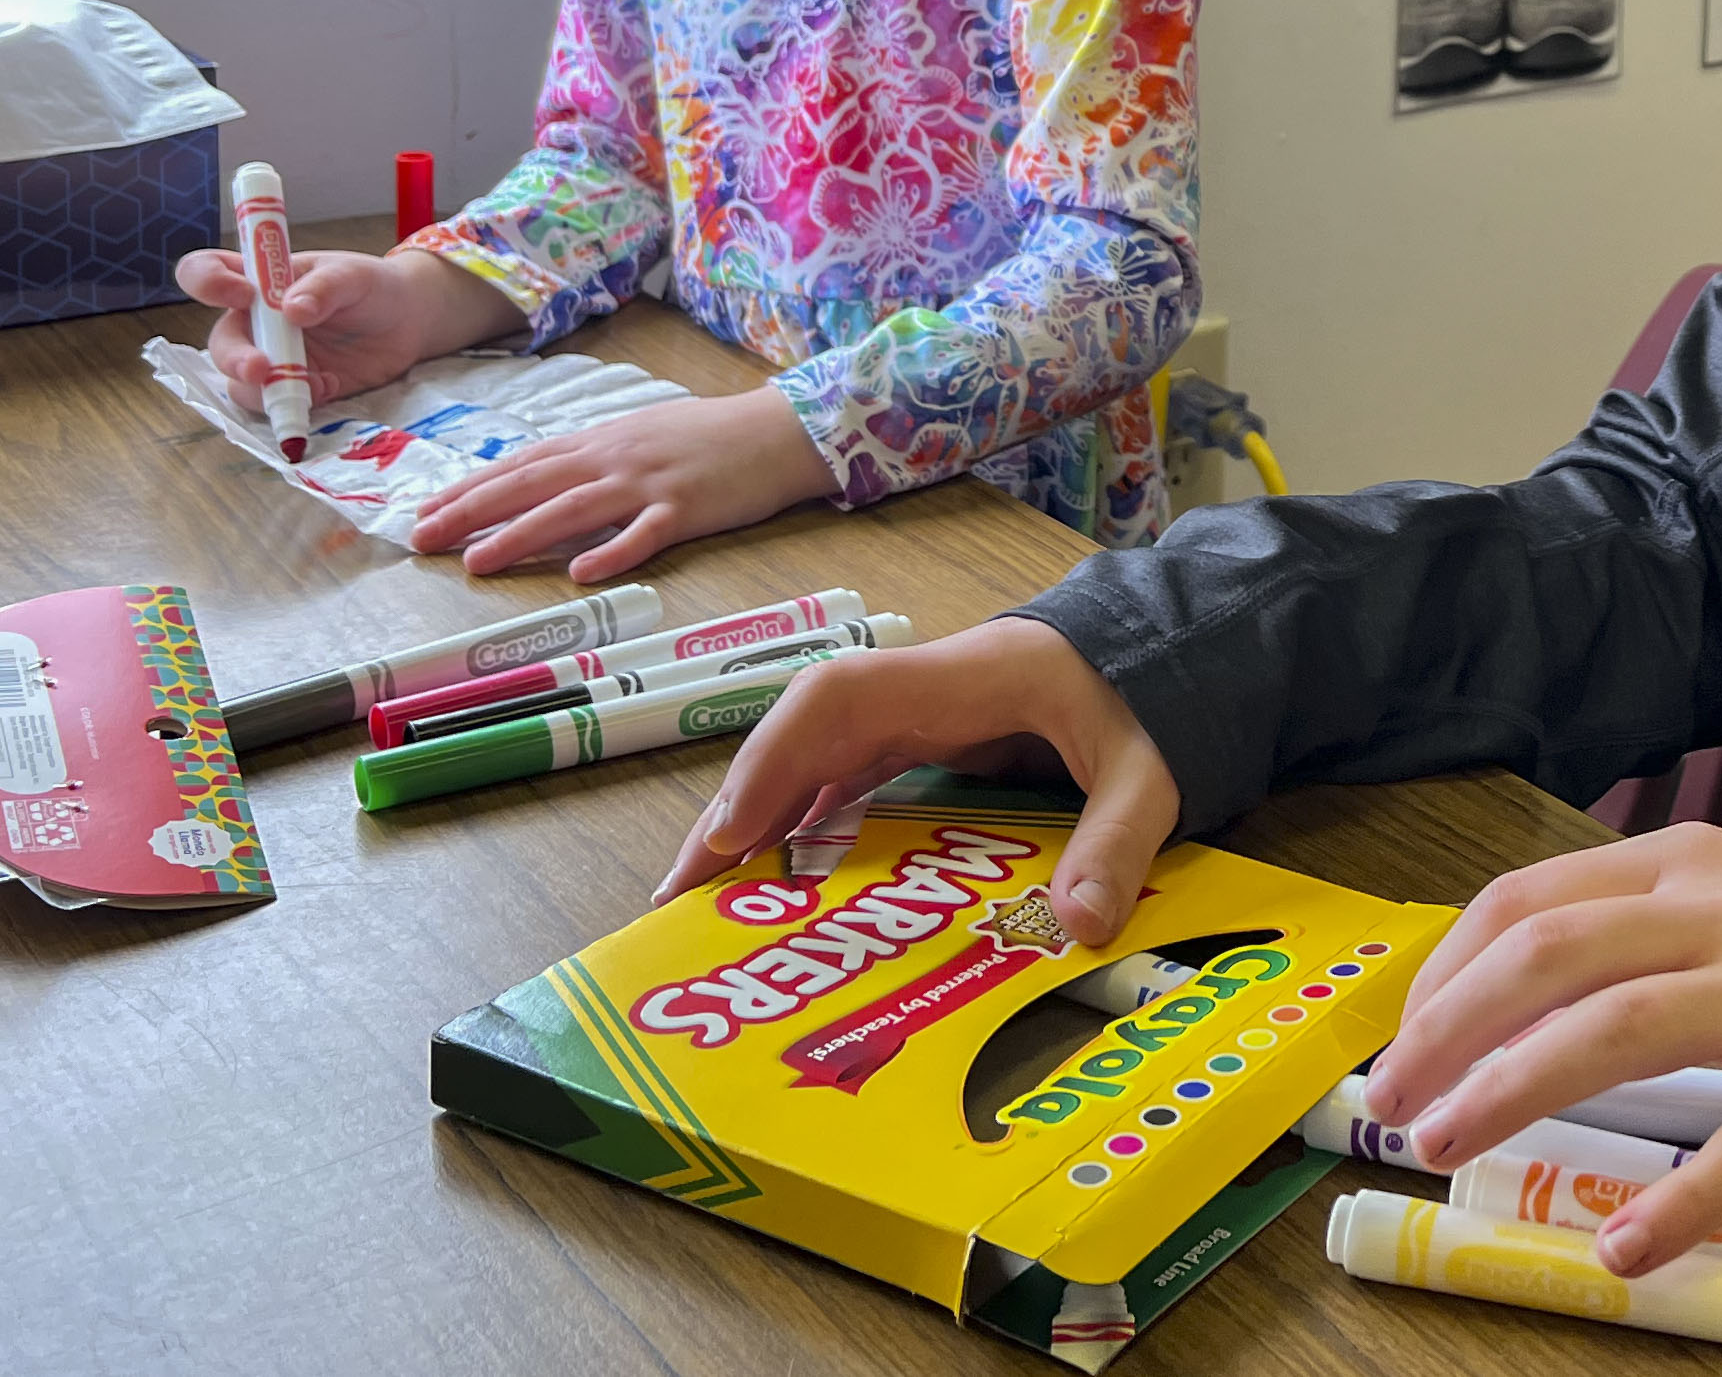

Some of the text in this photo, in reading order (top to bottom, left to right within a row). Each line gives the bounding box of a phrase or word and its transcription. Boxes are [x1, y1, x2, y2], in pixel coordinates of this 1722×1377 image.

[474, 623, 575, 669] Crayola
[639, 830, 1033, 1044] MARKERS
[729, 883, 808, 921] 10
[807, 953, 1007, 1062] Preferred by Teachers!
[1009, 948, 1291, 1124] Crayola
[1153, 1227, 1231, 1287] Broad Line
